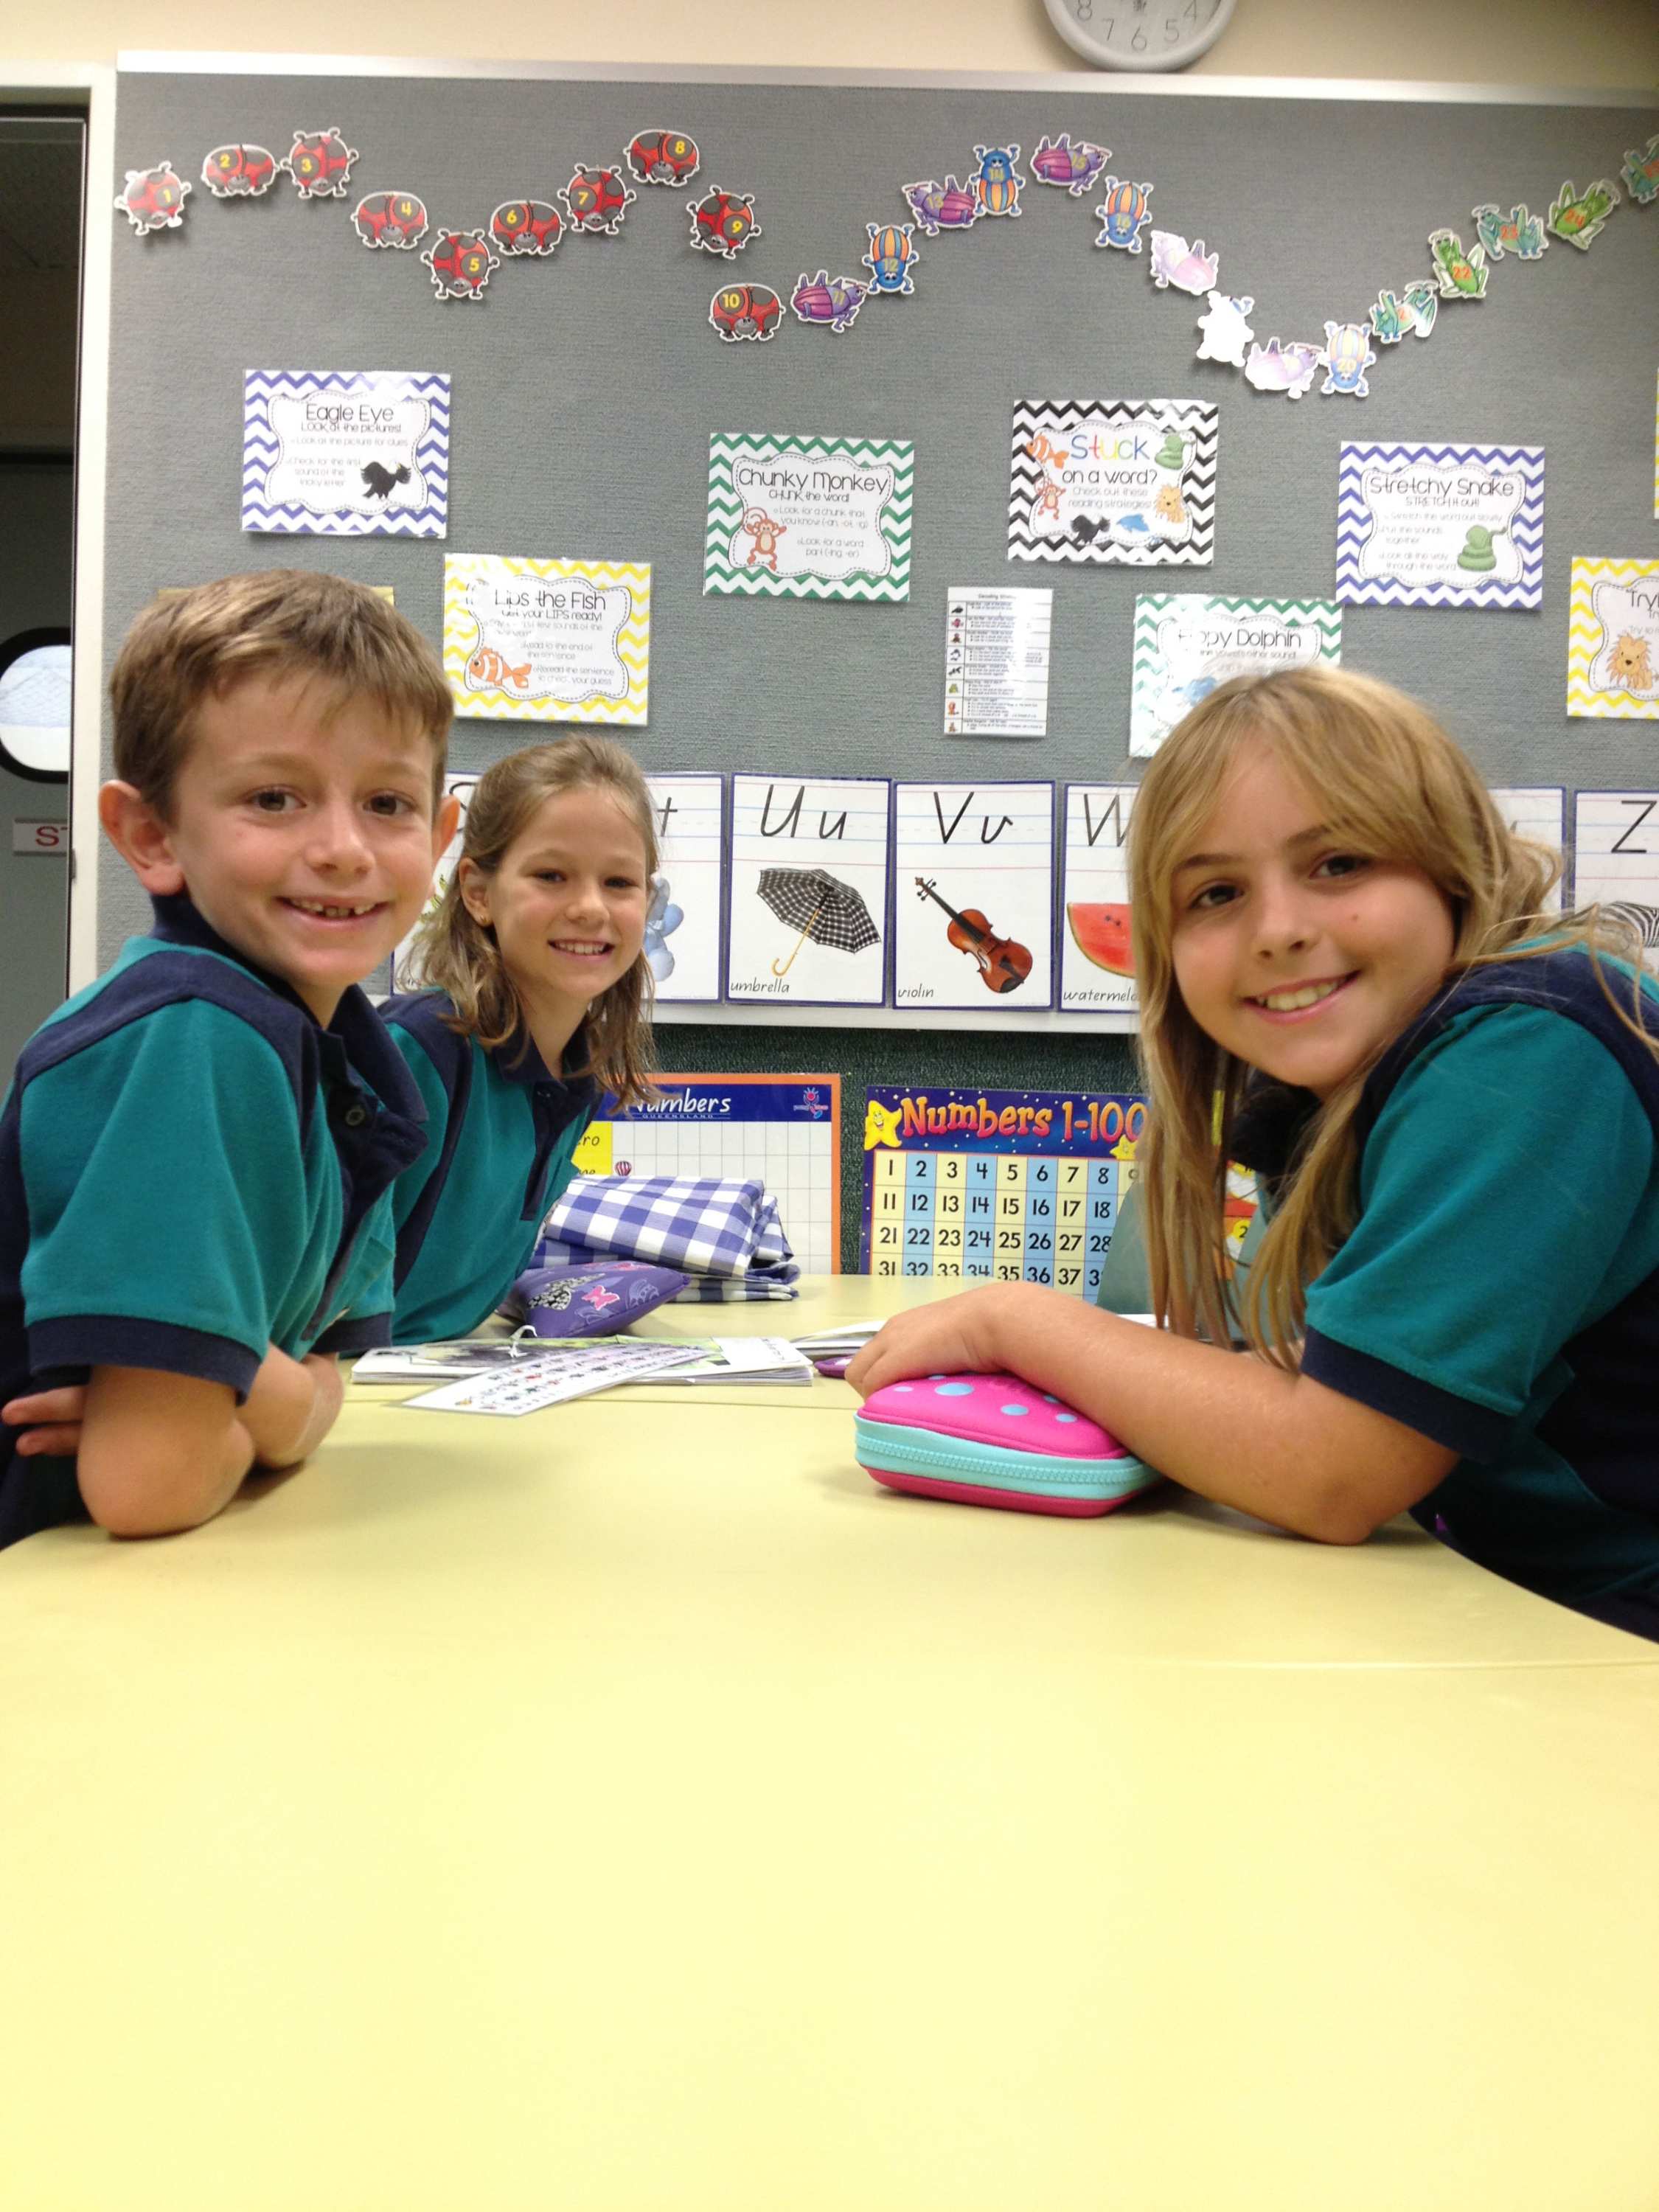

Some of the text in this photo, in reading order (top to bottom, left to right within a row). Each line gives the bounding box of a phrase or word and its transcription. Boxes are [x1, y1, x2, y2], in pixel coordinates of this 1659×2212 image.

[1102, 18, 1114, 41] 7
[1164, 19, 1180, 42] 5
[1131, 25, 1147, 52] 6
[675, 141, 685, 154] 8
[220, 155, 230, 167] 2
[302, 159, 312, 173] 3
[1072, 154, 1086, 169] 15
[989, 168, 1004, 181] 14
[163, 189, 171, 203] 1
[579, 192, 588, 206] 7
[927, 194, 943, 209] 13
[401, 202, 411, 215] 4
[507, 210, 518, 223] 6
[1565, 209, 1585, 228] 24
[732, 220, 742, 234] 9
[469, 258, 480, 272] 5
[884, 259, 898, 272] 12
[1453, 266, 1472, 279] 22
[723, 294, 740, 307] 10
[307, 403, 394, 424] Eagle Eye
[302, 422, 328, 433] Look
[344, 423, 358, 432] the
[361, 423, 401, 434] pictures!
[1071, 435, 1150, 460] Stuck
[739, 468, 888, 495] Chunky Monkey
[1062, 469, 1157, 484] on a word?
[1073, 486, 1147, 496] Check out these
[1371, 477, 1514, 497] Stretchy Snake
[805, 490, 821, 501] the
[779, 506, 799, 514] Look
[801, 506, 813, 514] for
[821, 507, 846, 515] chunk
[1068, 498, 1102, 509] reading
[781, 517, 820, 526] you know
[801, 537, 821, 546] Look
[844, 539, 864, 548] word
[806, 549, 822, 557] part
[536, 589, 566, 608] the
[571, 591, 606, 611] Fish
[523, 611, 544, 619] your
[546, 611, 569, 619] LIPS
[571, 612, 602, 622] ready!
[1237, 629, 1301, 649] Dolphin
[572, 677, 588, 685] your
[658, 797, 678, 837] t
[761, 785, 846, 839] U u
[933, 791, 1013, 844] V v
[1611, 801, 1657, 853] Z
[35, 825, 68, 846] S
[731, 978, 790, 993] umbrella
[898, 984, 933, 998] violin
[901, 1096, 1146, 1142] Numbers 1-100
[889, 1159, 1109, 1184] 1 2 3 4 5 6 7 8
[884, 1193, 1110, 1218] 11 12 13 14 15 16 17 18
[880, 1227, 1112, 1252] 21 22 23 24 25 26 27 28
[879, 1261, 896, 1276] 31
[998, 1265, 1020, 1281] 35
[1027, 1267, 1051, 1284] 36
[1058, 1268, 1081, 1285] 37
[1089, 1269, 1104, 1286] 3
